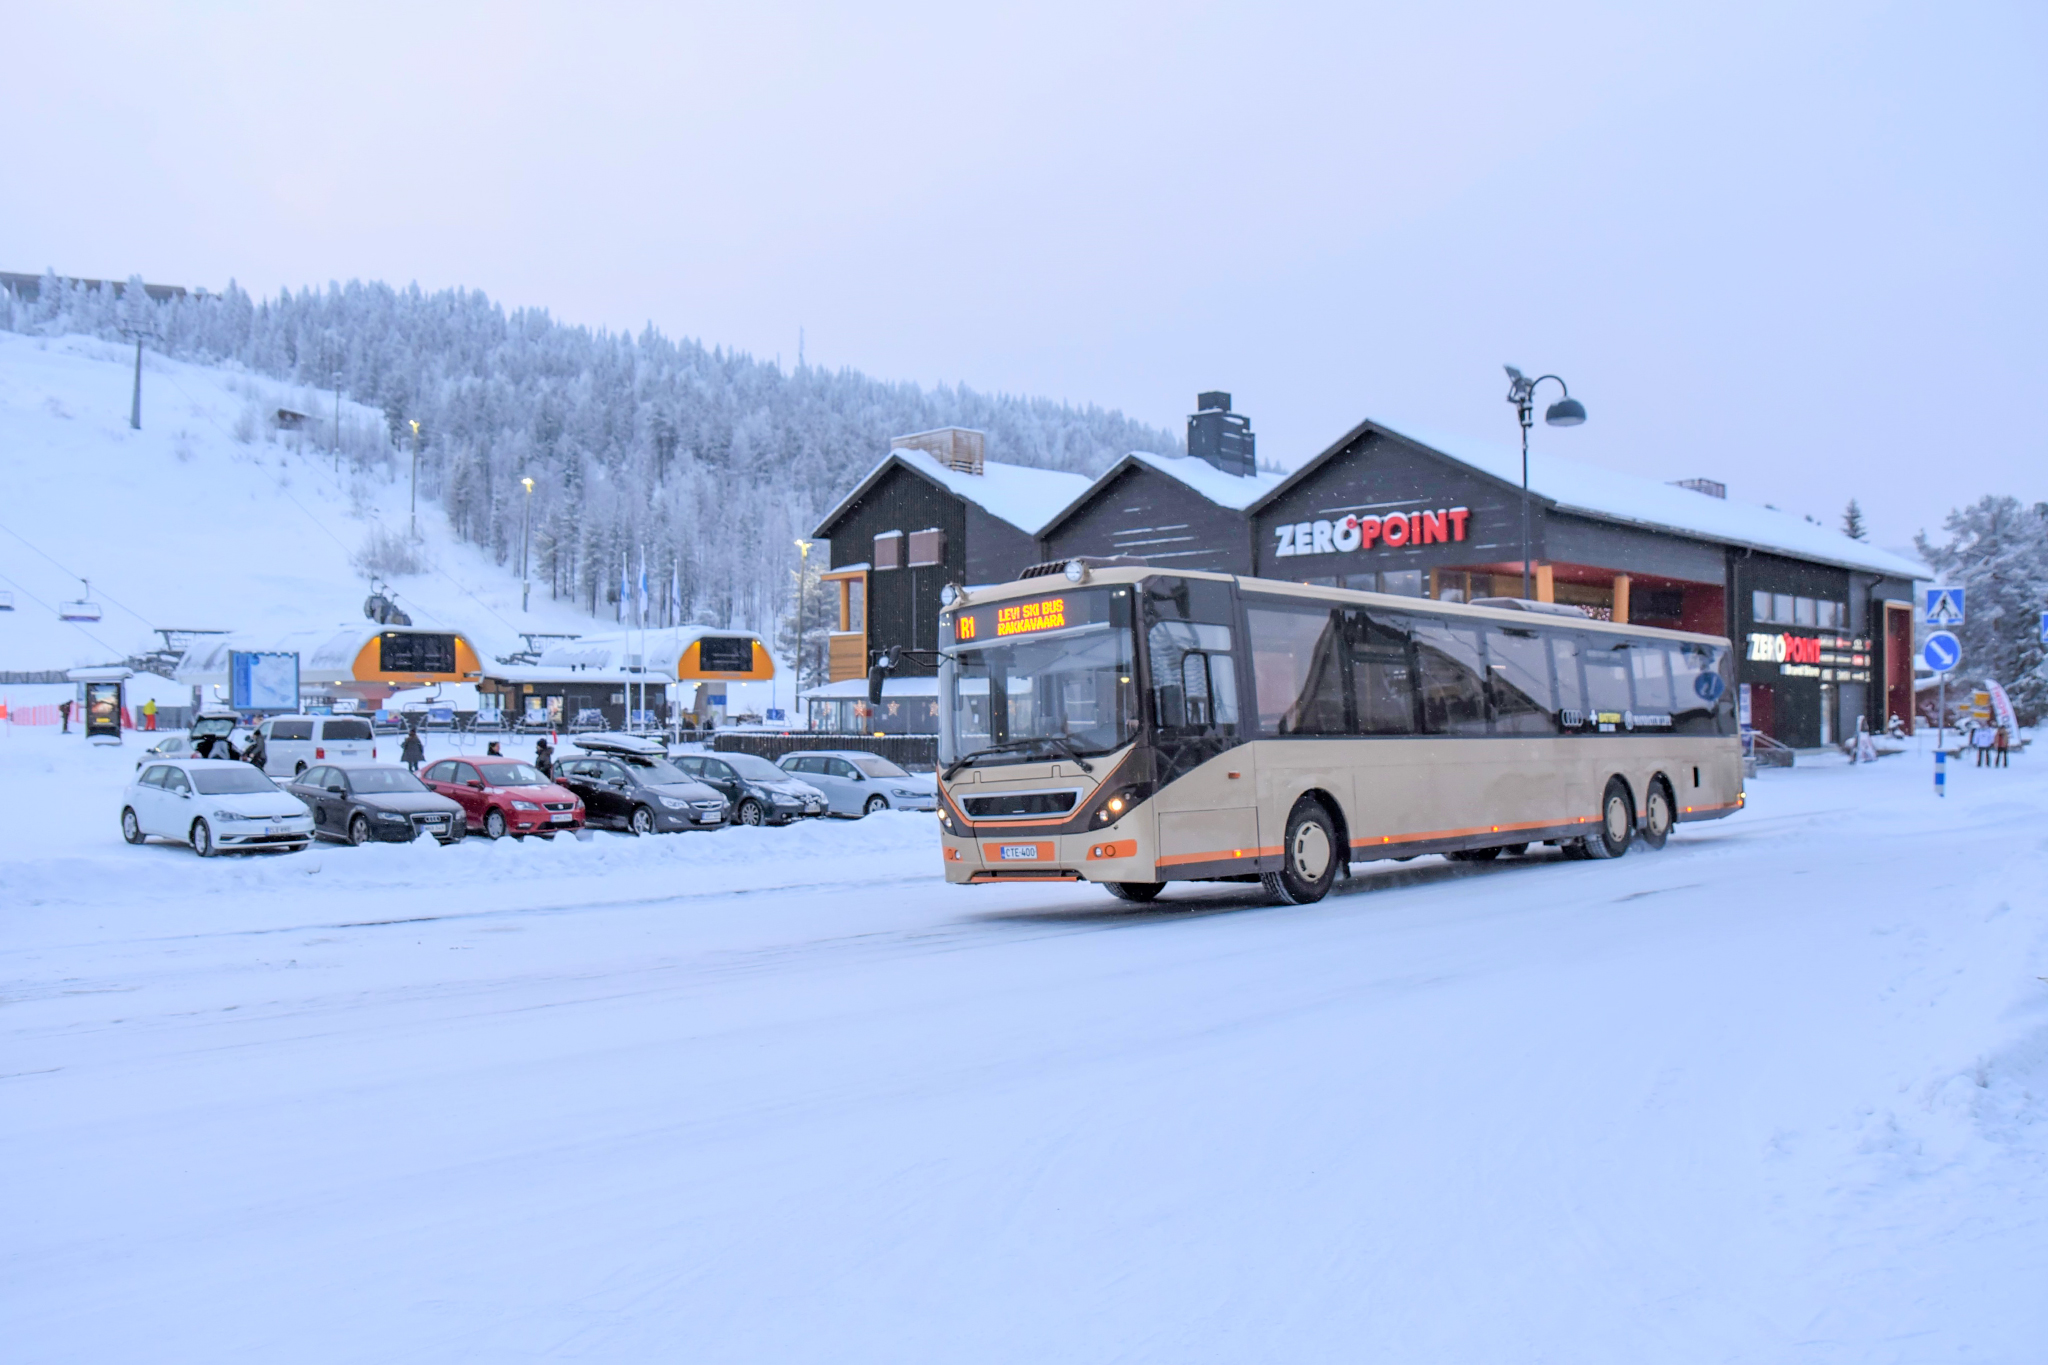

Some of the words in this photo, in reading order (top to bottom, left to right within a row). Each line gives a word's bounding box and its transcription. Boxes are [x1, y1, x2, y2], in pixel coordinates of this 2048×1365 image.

[998, 606, 1021, 623] LEVI
[1022, 603, 1040, 618] SKI
[1041, 599, 1064, 615] BUS
[960, 616, 975, 639] R1
[997, 613, 1065, 636] RAKKAVAARA
[1005, 847, 1036, 858] CTE-400
